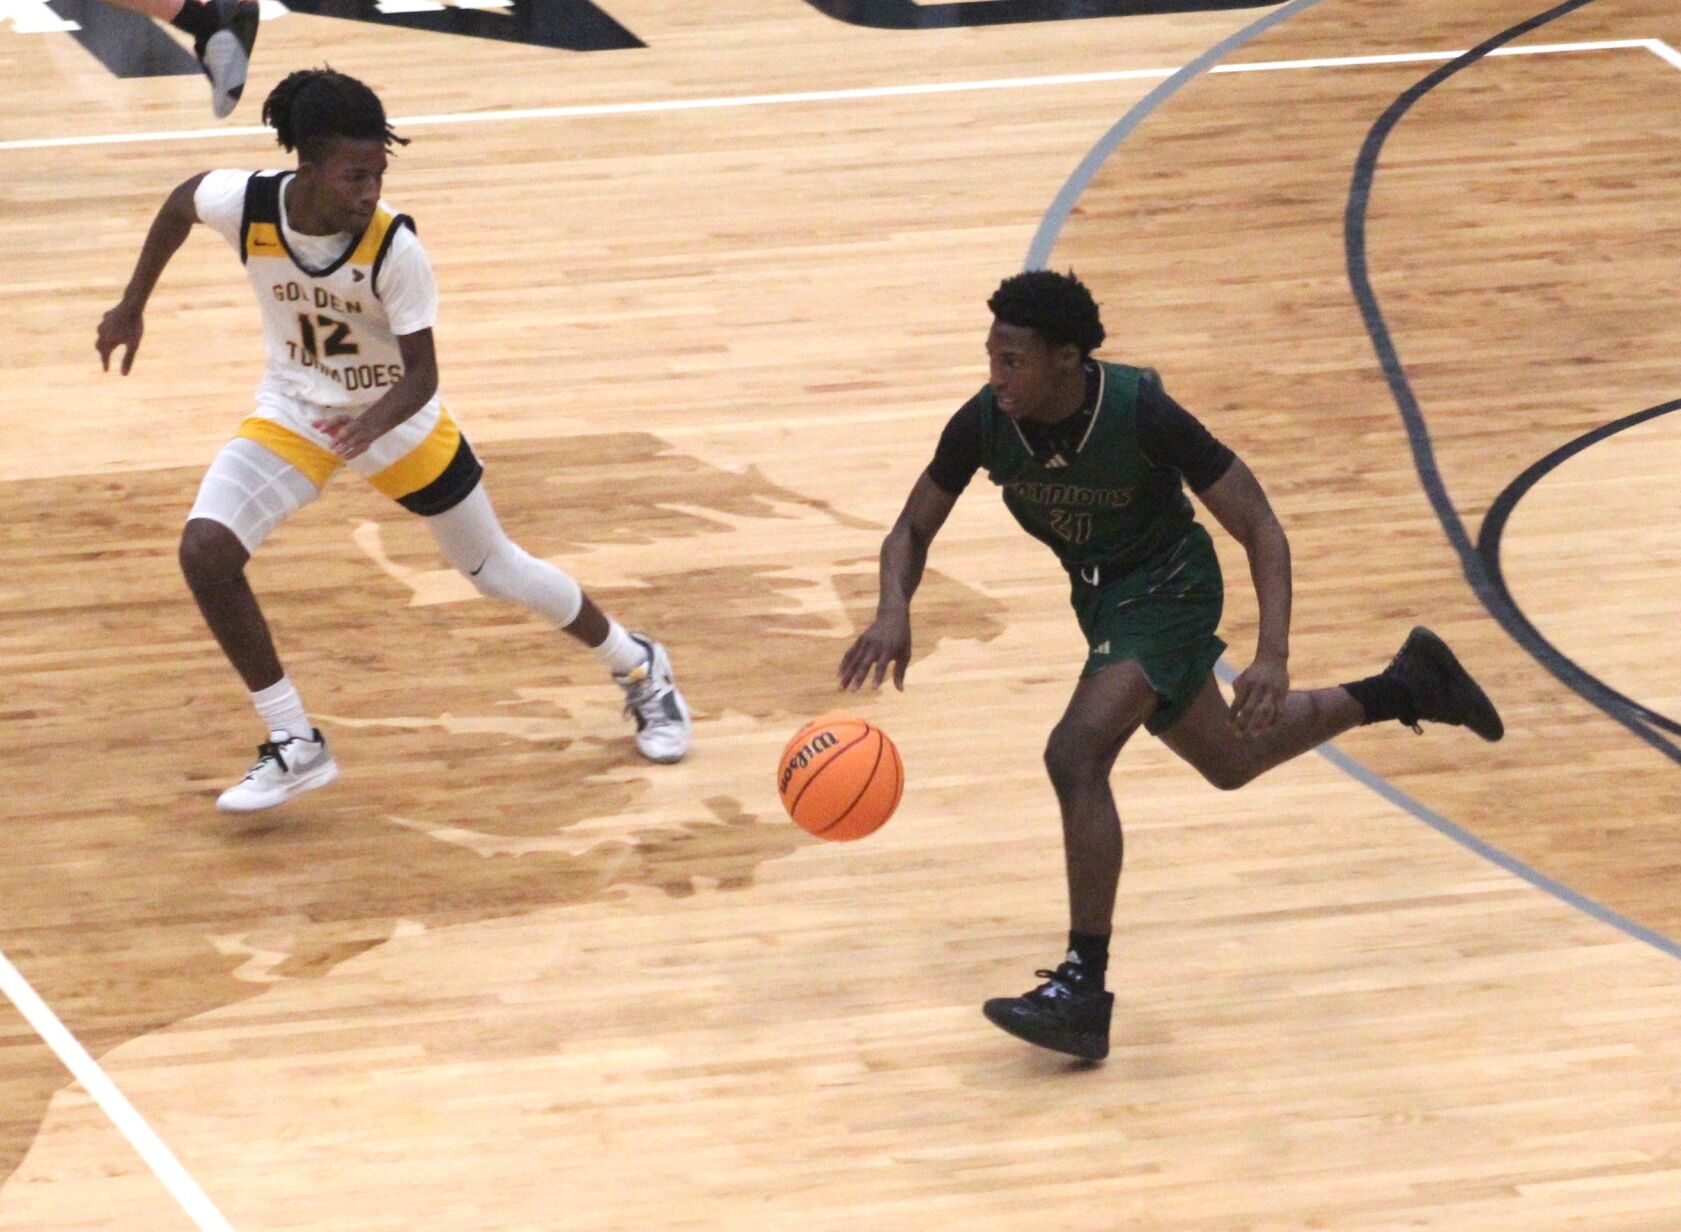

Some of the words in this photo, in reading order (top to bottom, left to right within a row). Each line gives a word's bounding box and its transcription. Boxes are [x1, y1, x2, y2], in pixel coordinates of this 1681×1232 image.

[272, 281, 362, 314] GOLDEN
[298, 312, 359, 357] 12
[1050, 509, 1092, 544] 21
